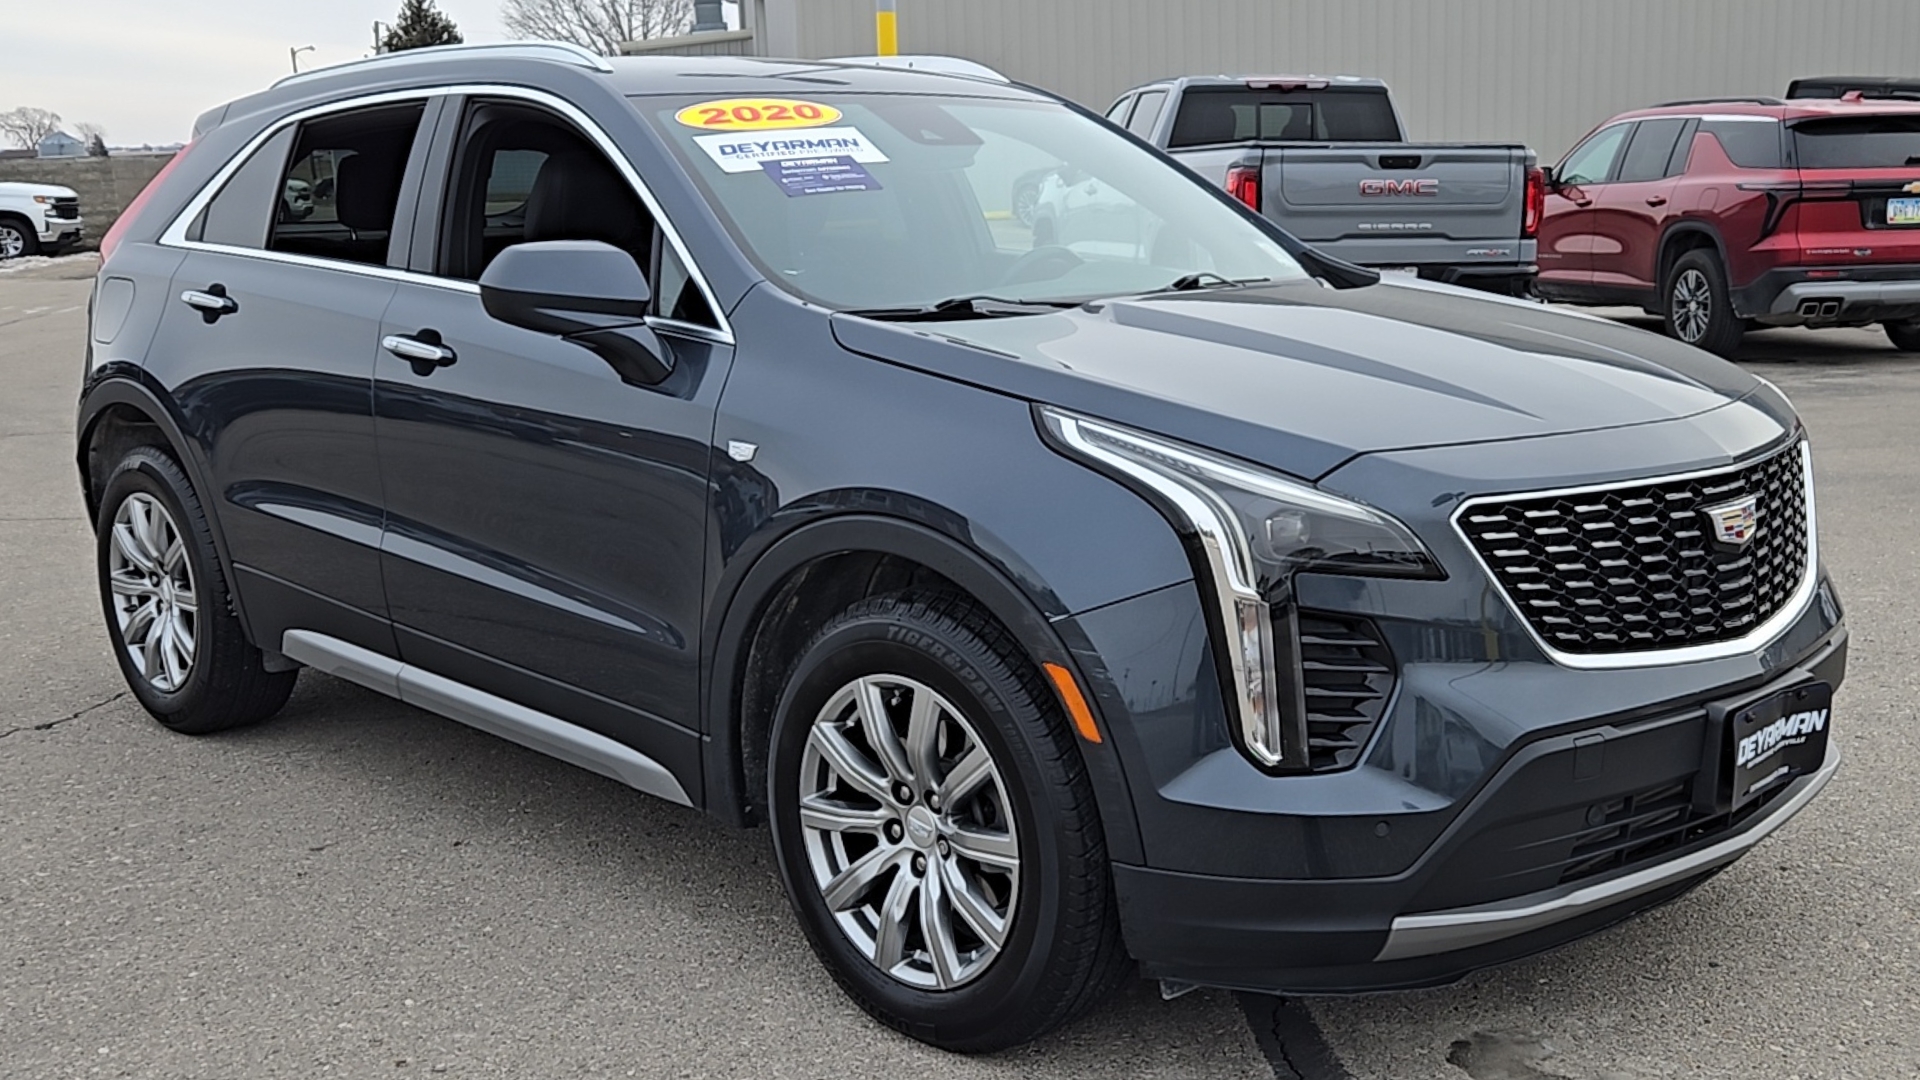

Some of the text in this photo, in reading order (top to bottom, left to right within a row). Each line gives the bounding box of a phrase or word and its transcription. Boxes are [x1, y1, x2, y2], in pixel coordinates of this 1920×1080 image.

[699, 104, 823, 125] 2020
[719, 137, 861, 156] DEYARMAN
[1358, 179, 1439, 196] GMC
[886, 625, 1004, 713] TIGER PAW
[1737, 708, 1828, 767] DEYARMAN
